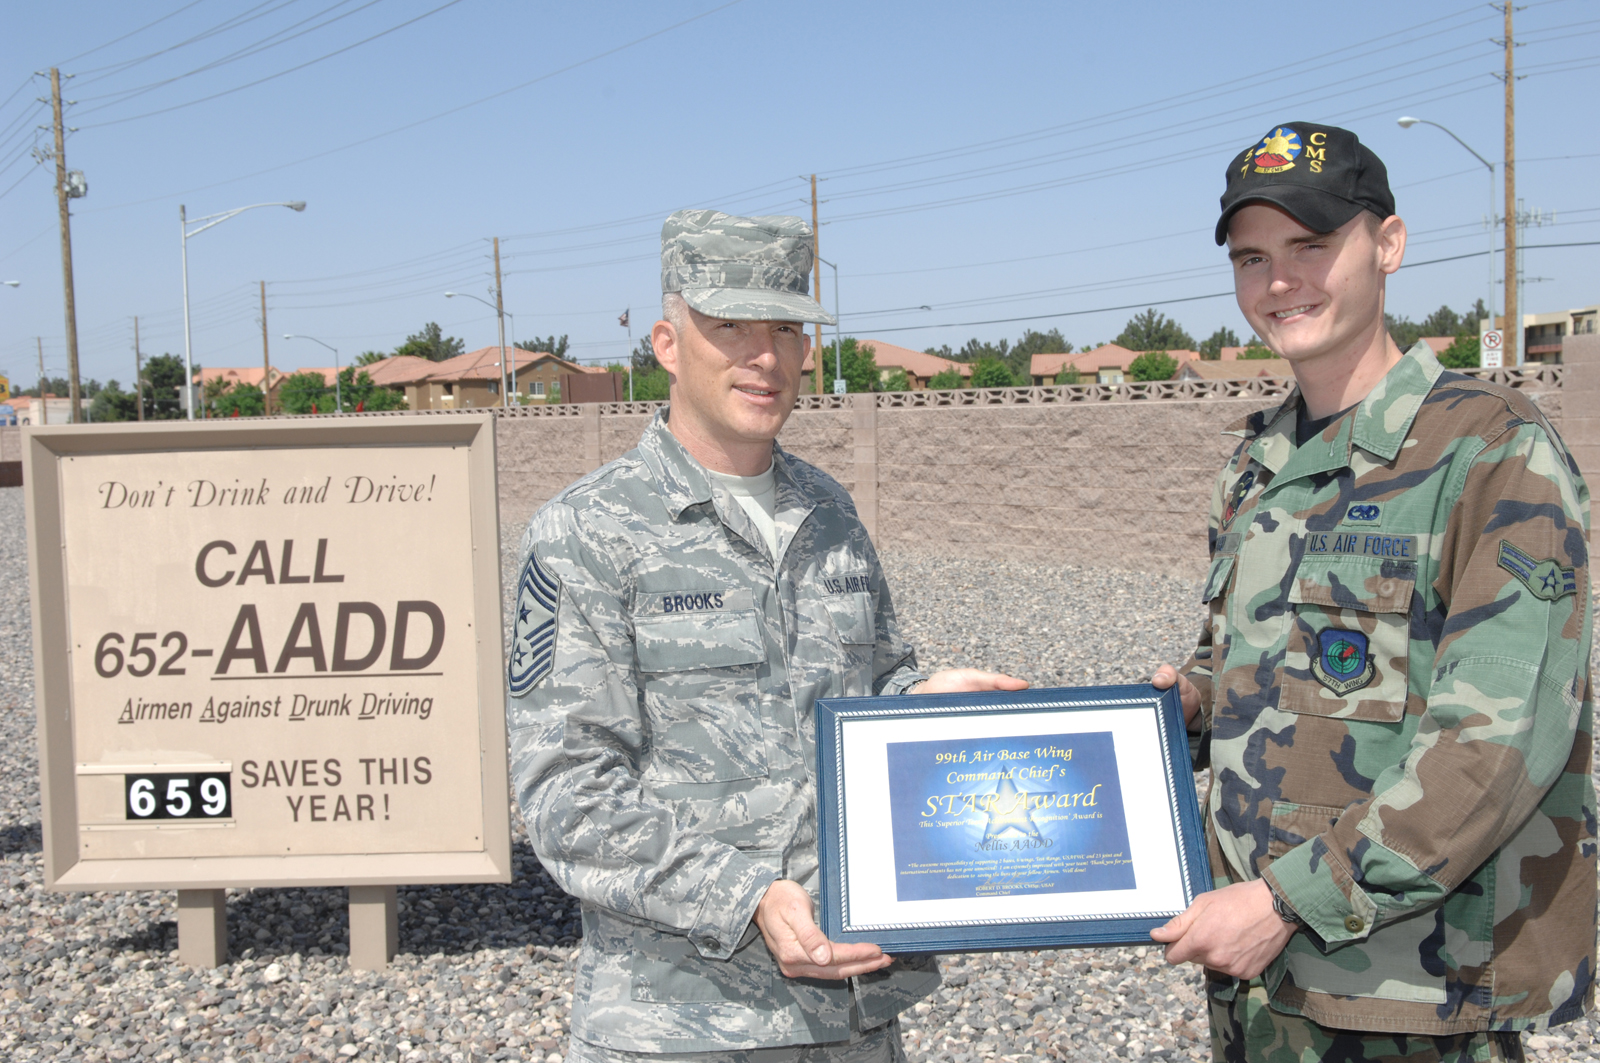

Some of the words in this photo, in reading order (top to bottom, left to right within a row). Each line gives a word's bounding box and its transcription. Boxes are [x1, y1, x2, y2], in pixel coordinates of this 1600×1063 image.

[98, 480, 176, 509] Don't
[187, 478, 270, 507] Drink
[283, 476, 331, 504] and
[344, 474, 436, 503] Drive!
[1310, 534, 1328, 552] U.S.
[1333, 534, 1358, 553] AIR
[1364, 535, 1411, 557] FORCE
[195, 538, 345, 588] CALL
[823, 578, 845, 594] U.S.
[845, 576, 861, 593] AIR
[663, 593, 724, 613] BROOKS
[94, 600, 446, 680] 652-AADD
[1343, 678, 1364, 689] WING
[118, 697, 192, 724] Airmen
[199, 695, 282, 724] Against
[288, 693, 353, 721] Drunk
[358, 692, 434, 720] Driving
[935, 750, 967, 765] 99th
[969, 750, 995, 764] Air
[997, 749, 1030, 761] Base
[1034, 746, 1073, 761] Wing
[946, 767, 1018, 784] Command
[1018, 764, 1067, 782] Chief's
[129, 777, 227, 817] 659
[241, 758, 342, 788] SAVES
[359, 756, 433, 786] THIS
[286, 793, 390, 822] YEAR!
[921, 792, 1013, 817] STAR
[1012, 783, 1102, 811] Award
[919, 820, 934, 828] This
[1071, 812, 1097, 821] Award
[974, 840, 1008, 852] Nellis
[1010, 838, 1053, 851] AADD
